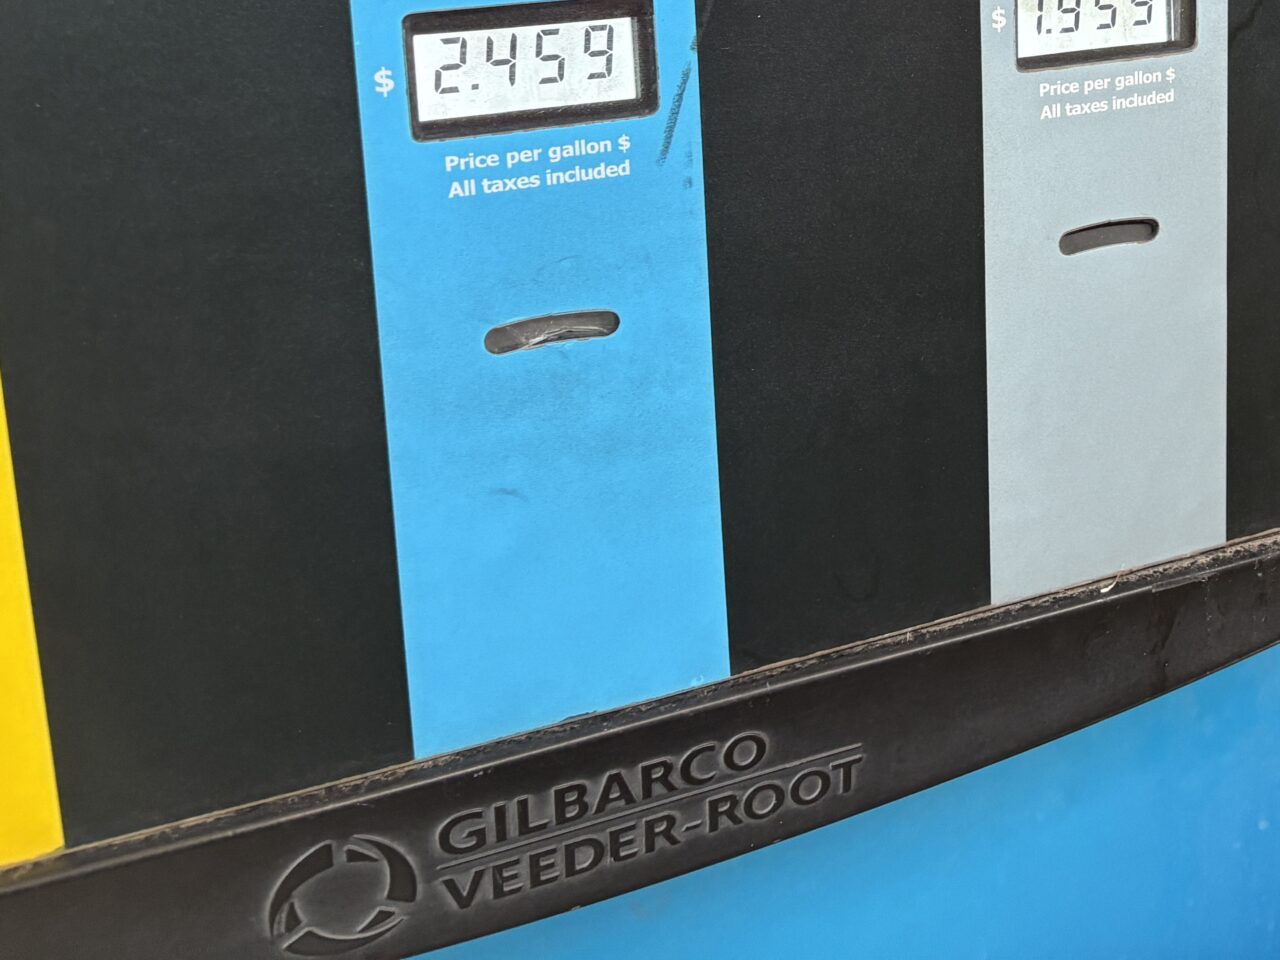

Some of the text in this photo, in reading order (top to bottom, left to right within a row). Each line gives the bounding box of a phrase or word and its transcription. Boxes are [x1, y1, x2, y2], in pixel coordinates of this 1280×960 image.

[992, 6, 1007, 33] $
[373, 23, 614, 98] $ 2.459
[1039, 68, 1176, 97] Price per gallon $
[1040, 89, 1174, 120] All taxes included
[445, 134, 631, 172] Price per gallon $
[449, 160, 630, 198] All taxes included
[437, 731, 768, 857] GILBARCO
[440, 754, 863, 910] VEEDER-ROOT
